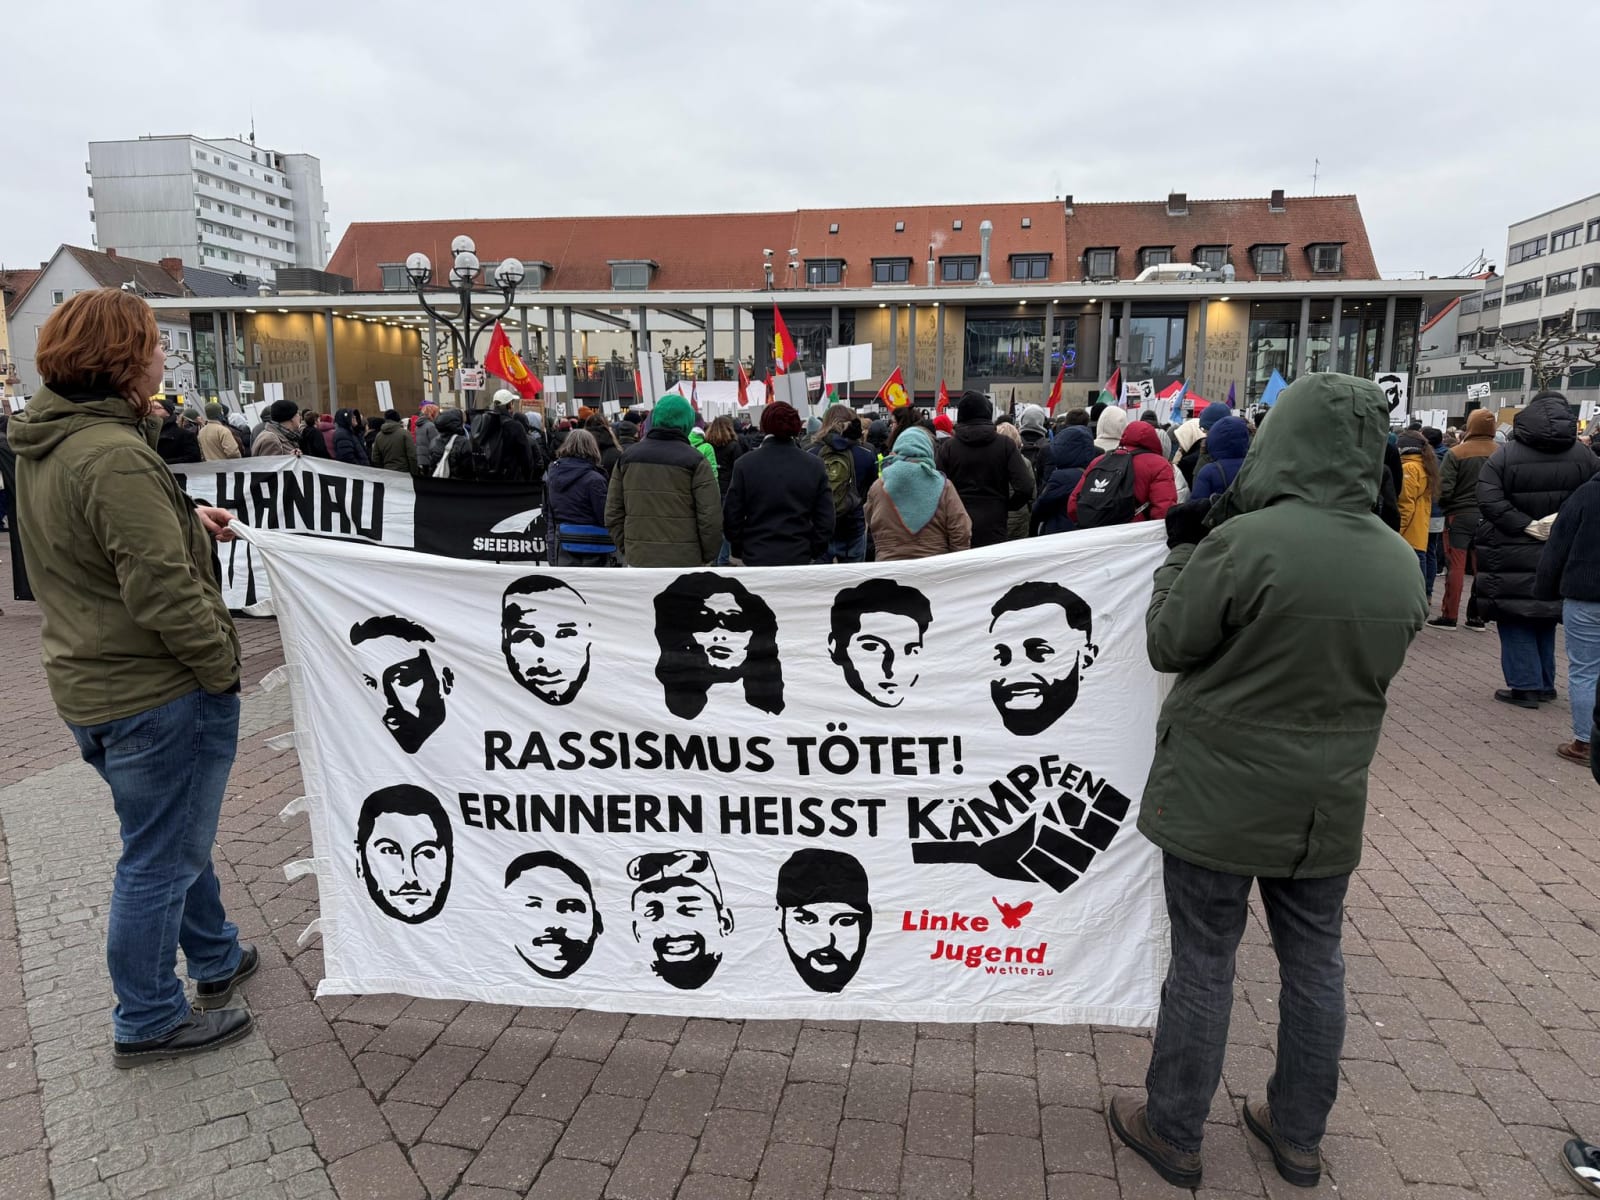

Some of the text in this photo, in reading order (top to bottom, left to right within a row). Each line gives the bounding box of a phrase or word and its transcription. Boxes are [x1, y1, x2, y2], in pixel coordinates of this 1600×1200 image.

[216, 470, 385, 541] HANAU
[472, 537, 548, 553] SEEBRÜ
[484, 722, 964, 775] RASSISMUS TÖTET!
[458, 754, 1106, 841] ERINNERN HEISST KÄMPFEN
[901, 909, 989, 932] Linke
[930, 939, 1048, 968] Jugend
